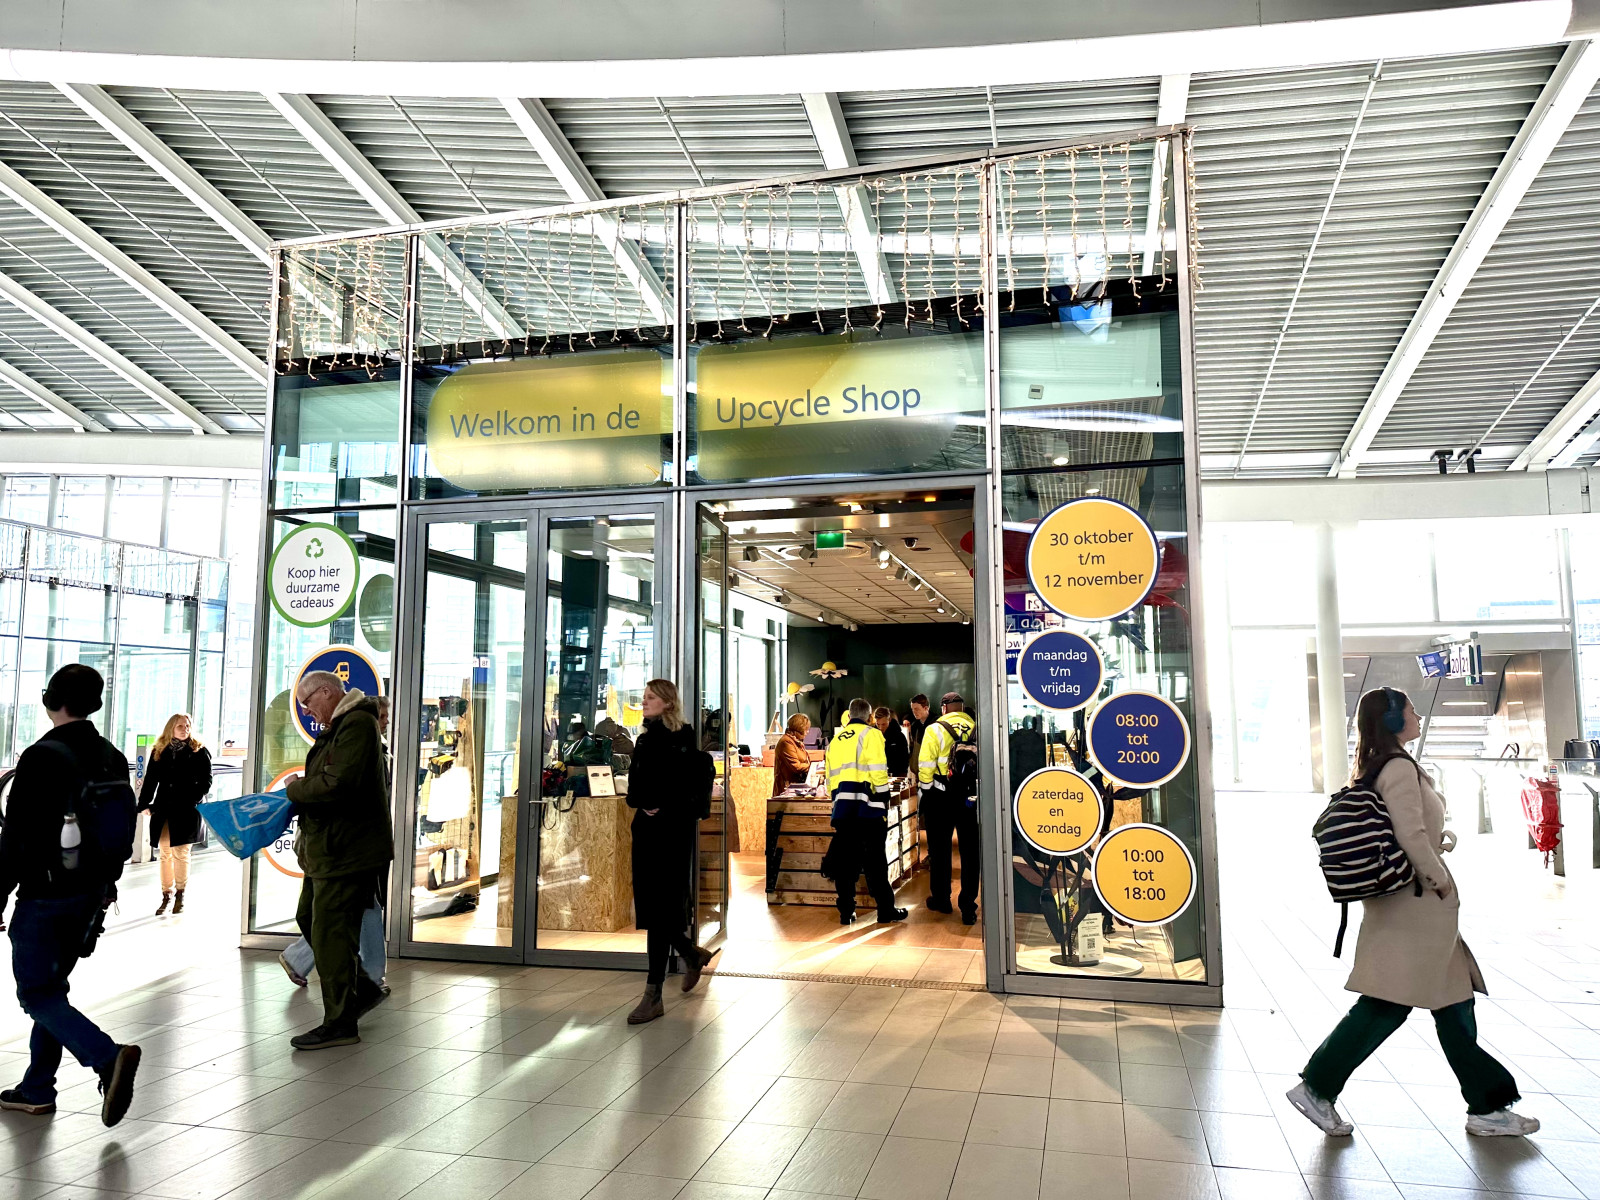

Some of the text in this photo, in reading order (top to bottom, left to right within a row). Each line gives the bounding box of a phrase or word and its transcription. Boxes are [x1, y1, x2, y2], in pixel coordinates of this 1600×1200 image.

[715, 385, 921, 429] Upcycle Shop
[450, 403, 640, 438] Welkom in de
[1050, 530, 1134, 547] 30 oktober
[1077, 552, 1105, 566] t/m
[287, 565, 341, 581] Koop hier
[1044, 571, 1144, 588] 12 november
[285, 581, 340, 594] duurzame
[290, 596, 334, 609] cadeaus
[1032, 649, 1088, 663] maandag
[1049, 665, 1071, 677] t/m
[1451, 657, 1469, 673] 20 21
[1040, 681, 1081, 696] vrijdag
[310, 721, 326, 731] tre
[1115, 713, 1159, 728] 08:00
[1126, 733, 1149, 746] tot
[1117, 750, 1160, 764] 20:00
[1032, 788, 1084, 803] zaterdag
[1049, 807, 1064, 817] en
[1037, 822, 1082, 837] zondag
[1122, 848, 1165, 863] 10:00
[1132, 868, 1155, 882] tot
[1124, 886, 1166, 901] 18:00
